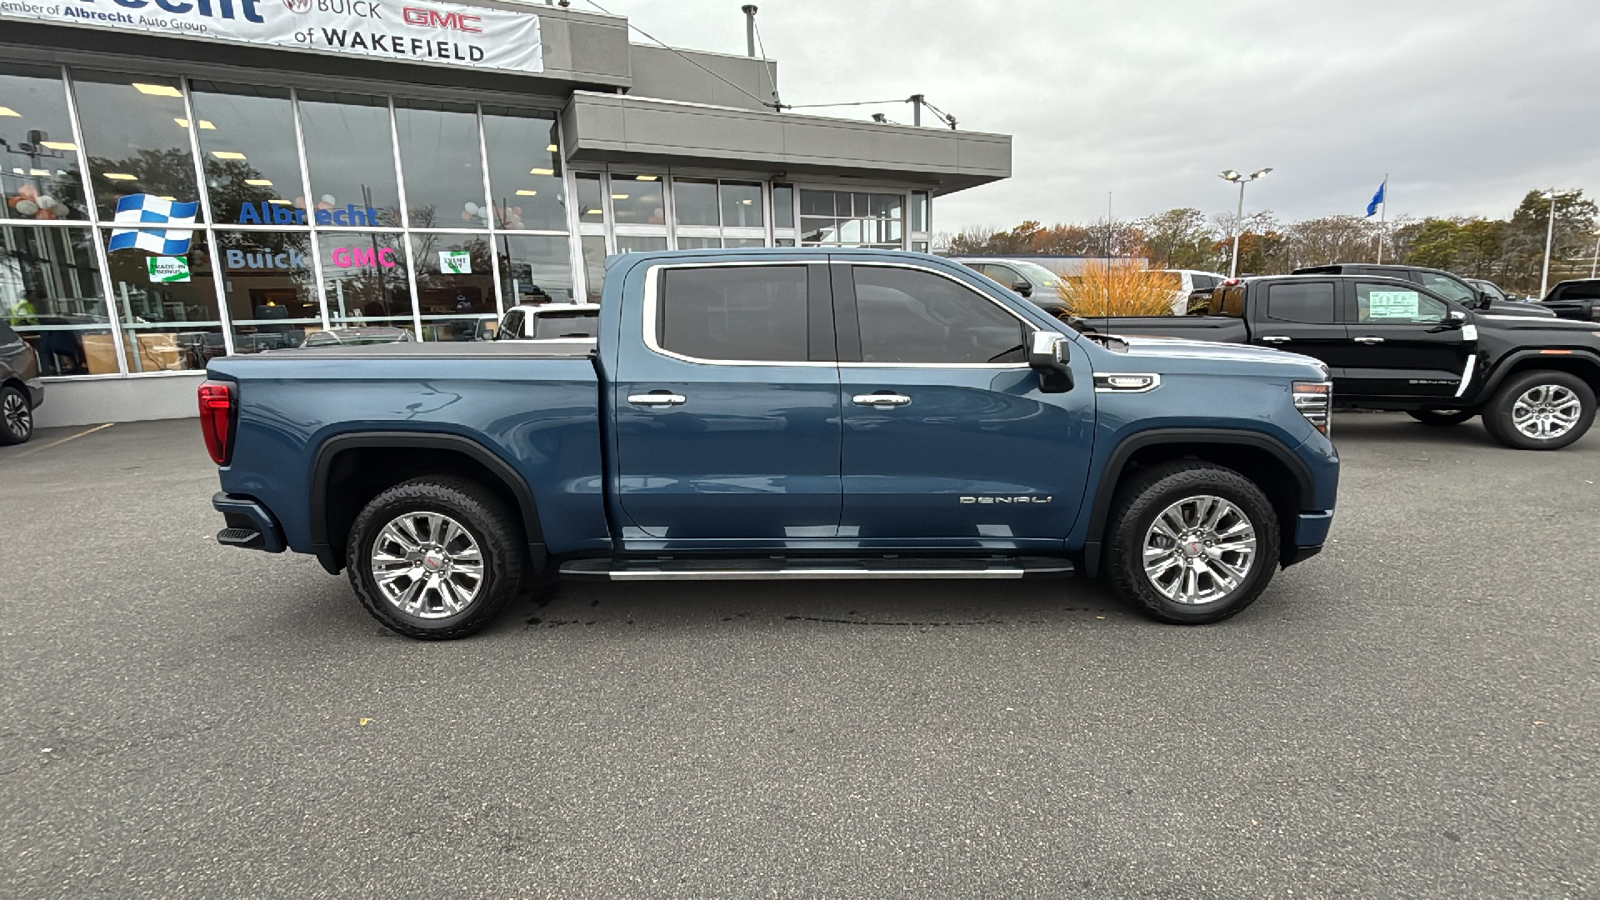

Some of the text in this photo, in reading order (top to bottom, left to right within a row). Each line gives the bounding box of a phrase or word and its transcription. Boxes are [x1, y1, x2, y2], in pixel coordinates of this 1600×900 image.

[0, 1, 44, 13] ember
[46, 4, 61, 15] of
[63, 6, 134, 24] Albrecht
[138, 14, 168, 28] Auto
[169, 18, 208, 33] Group
[317, 0, 383, 19] BUICK
[402, 6, 483, 34] GMC
[294, 27, 485, 62] of WAKEFIELD
[239, 200, 380, 226] Albrecht
[225, 247, 397, 270] Buick GMC
[959, 496, 1053, 504] DENALI
